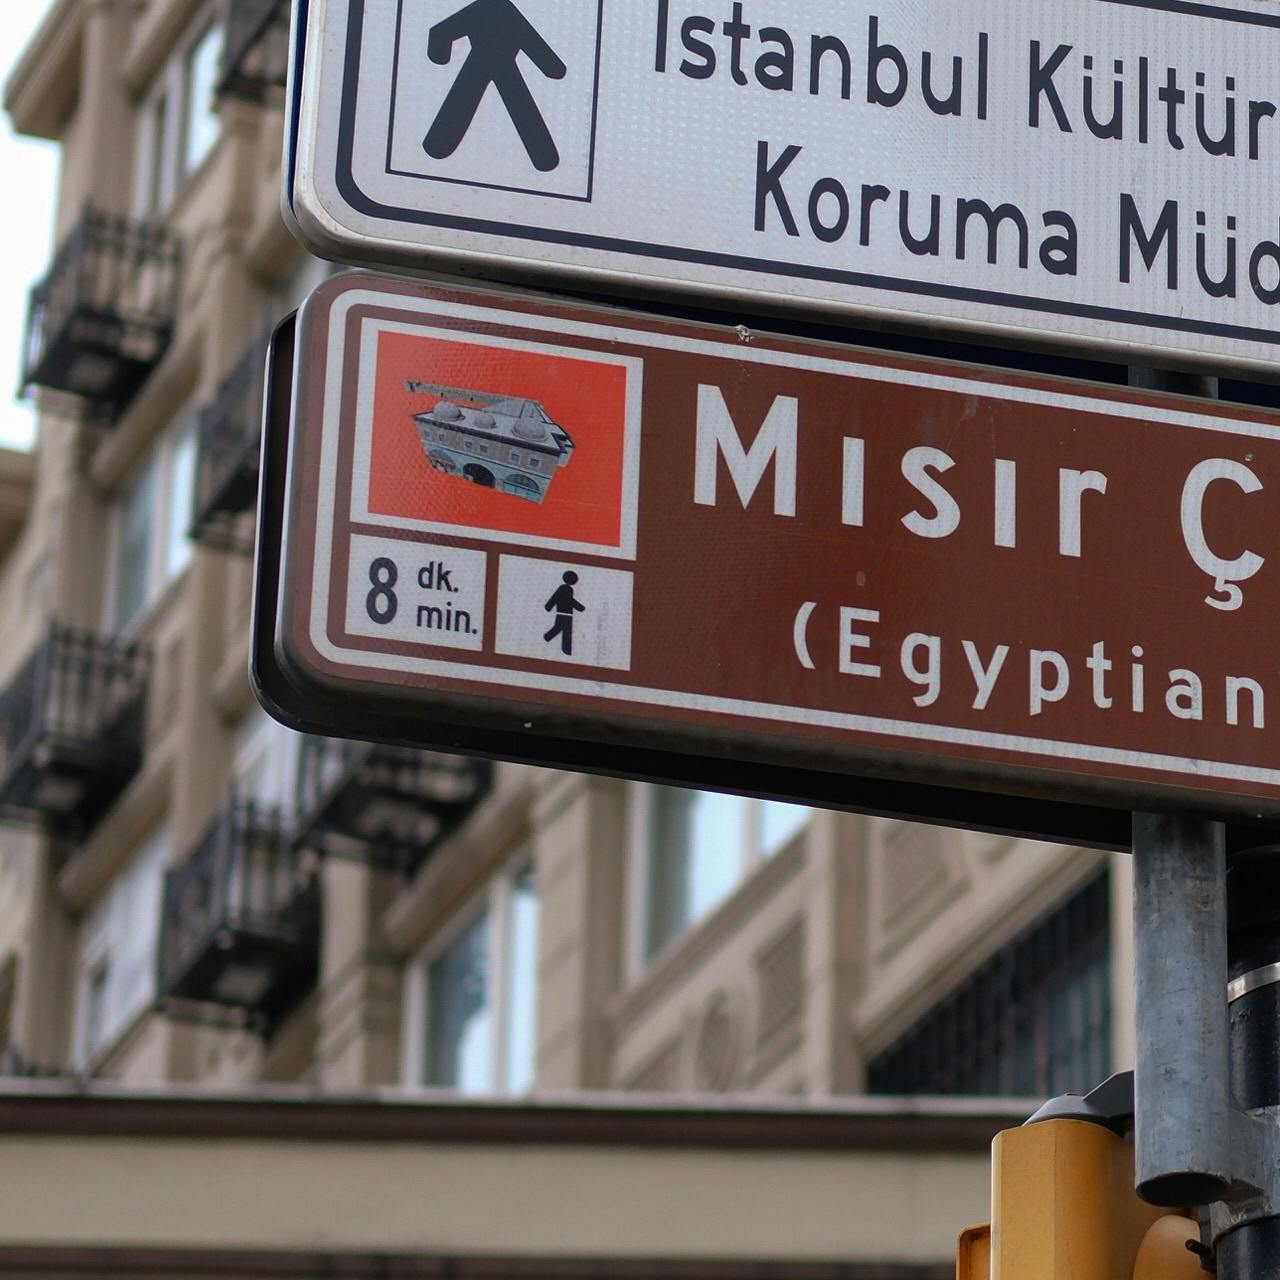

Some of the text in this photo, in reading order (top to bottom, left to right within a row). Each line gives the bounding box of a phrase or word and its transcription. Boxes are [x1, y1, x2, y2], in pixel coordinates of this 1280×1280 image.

[1028, 39, 1278, 161] Kültür
[753, 140, 1079, 277] Koruma
[692, 383, 1109, 558] Mısır
[366, 556, 460, 624] 8 dk.
[416, 600, 479, 635] min.
[793, 601, 1266, 730] (Egyptian
